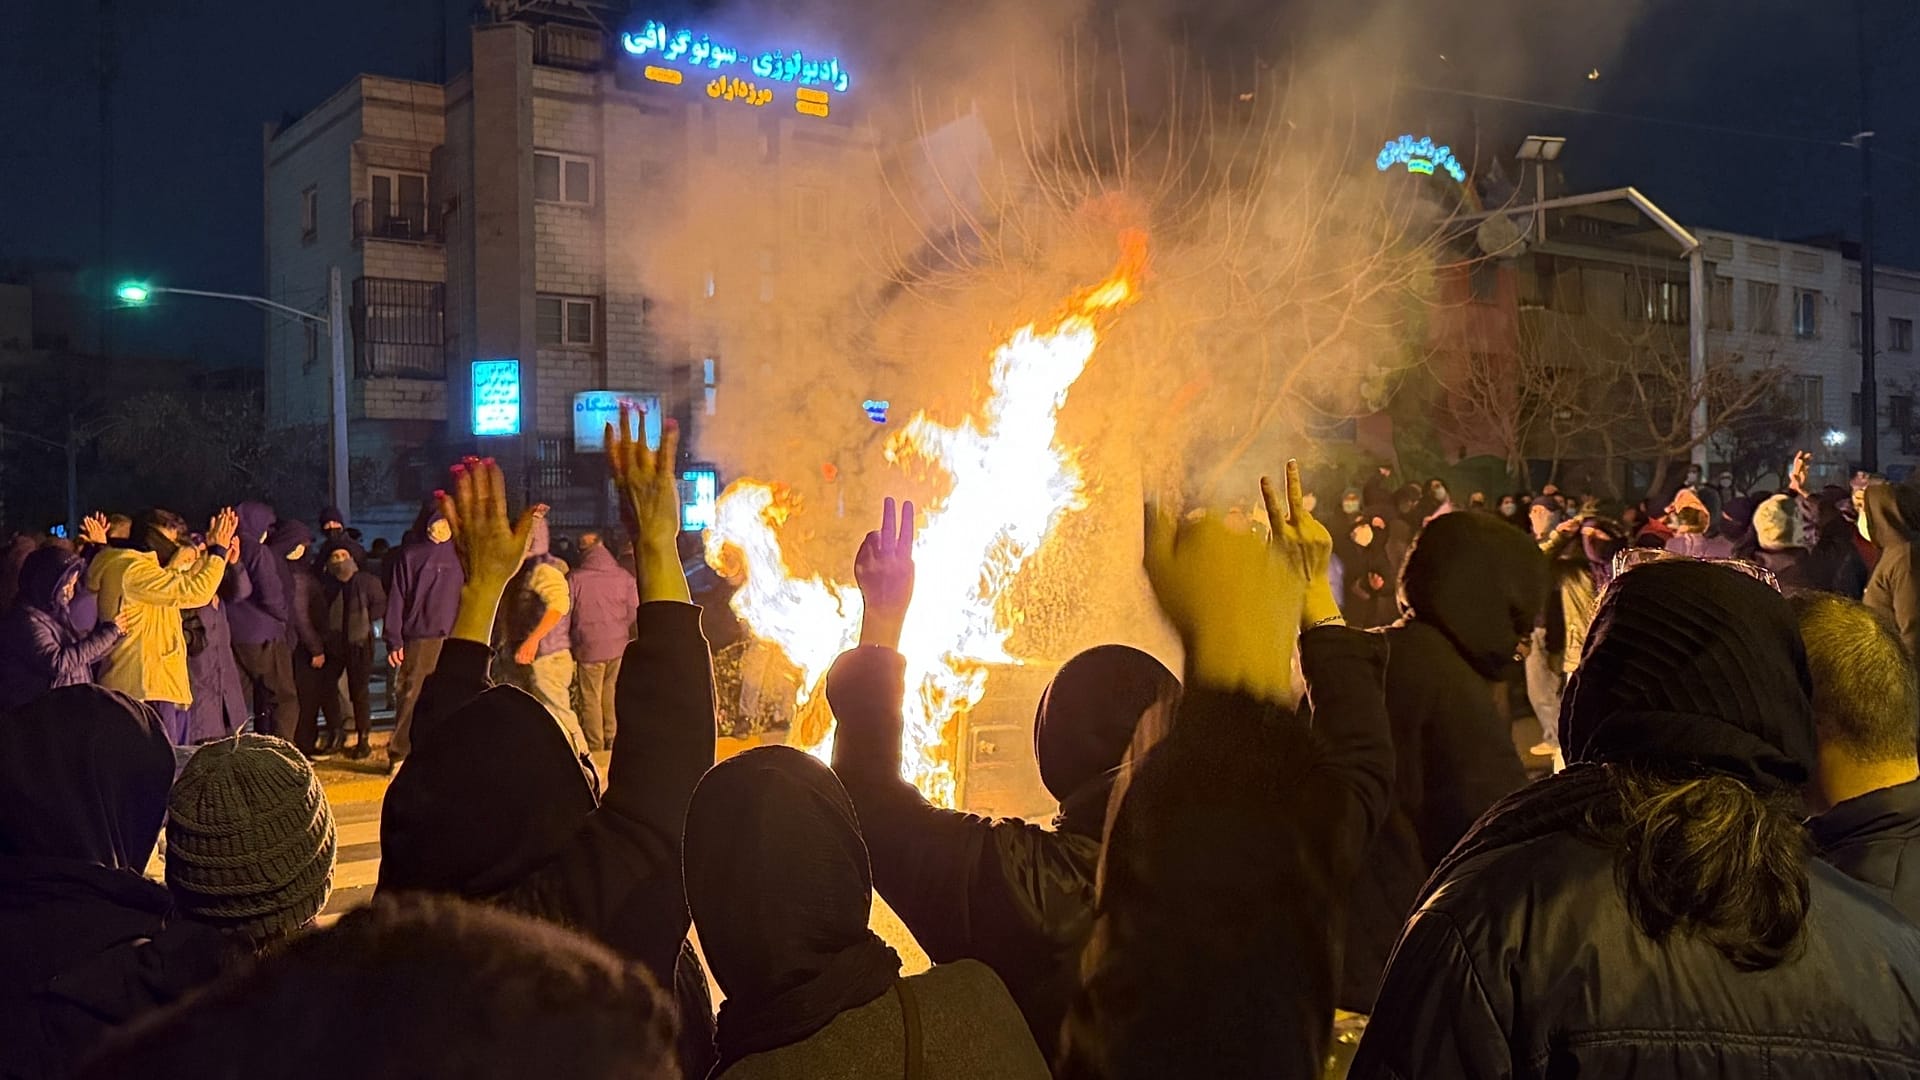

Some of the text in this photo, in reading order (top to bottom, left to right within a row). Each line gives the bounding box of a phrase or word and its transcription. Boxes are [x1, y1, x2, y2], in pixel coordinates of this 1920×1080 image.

[621, 19, 738, 69] سونوگرافی
[705, 74, 774, 106] مرزداران
[751, 49, 850, 92] رادیولوژی
